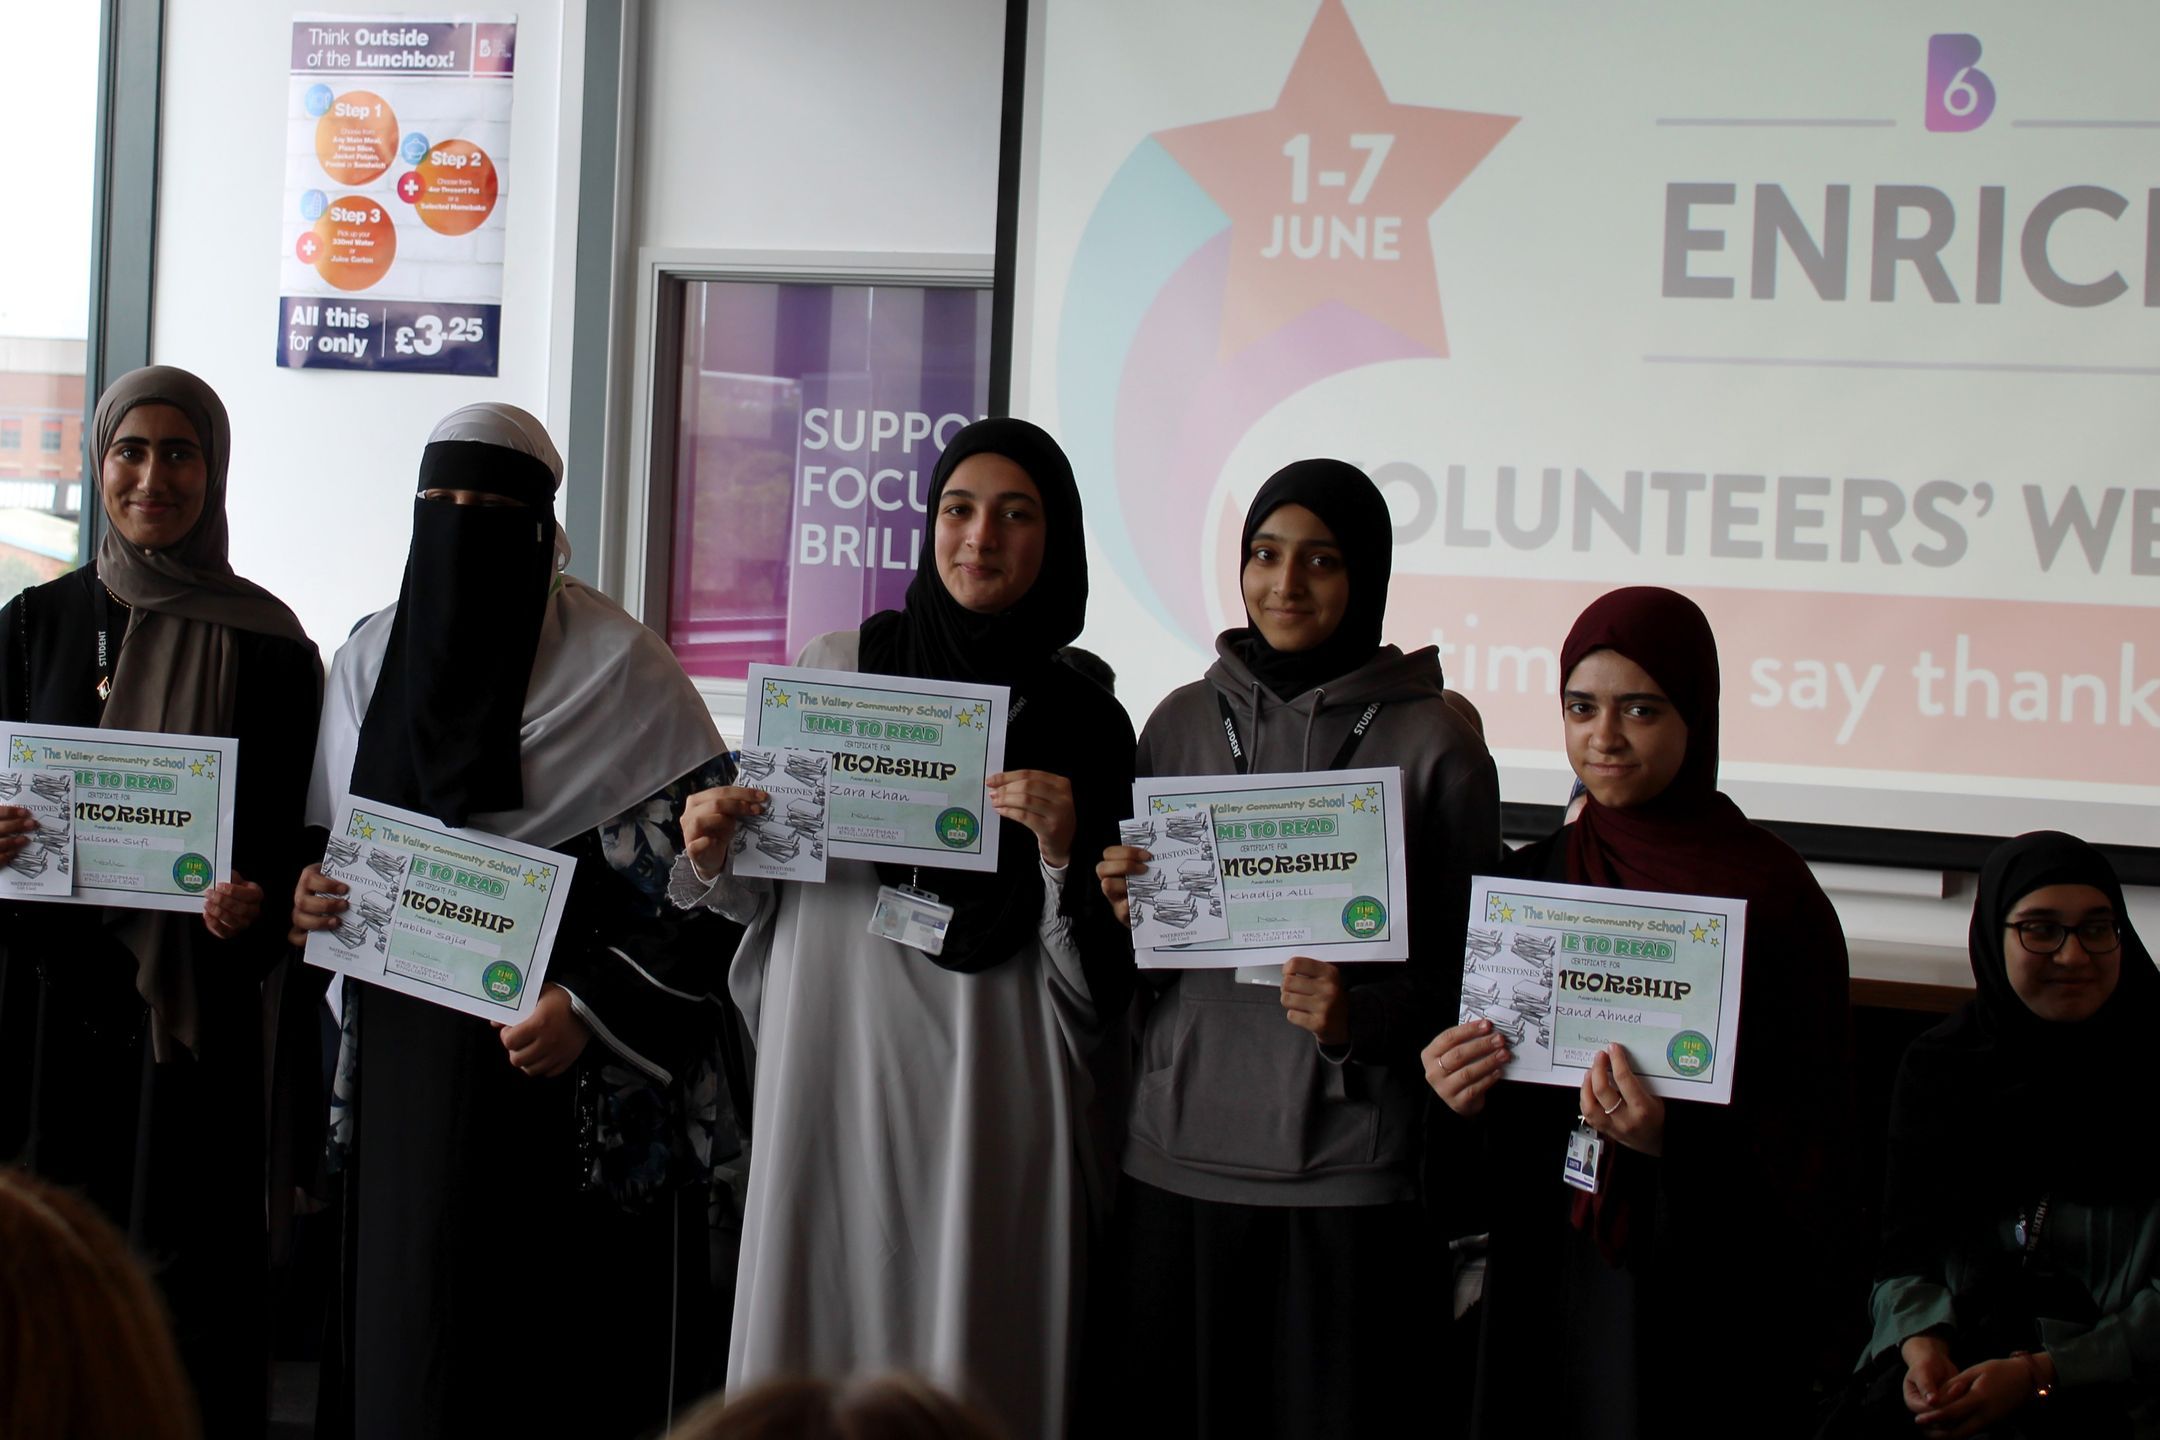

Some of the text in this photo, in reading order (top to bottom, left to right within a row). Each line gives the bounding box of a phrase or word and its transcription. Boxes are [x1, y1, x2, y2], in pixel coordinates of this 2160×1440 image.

[309, 28, 429, 47] Think Outside
[307, 49, 455, 68] of the Lunchbox!
[335, 103, 381, 120] Step 1
[431, 152, 482, 170] Step 2
[331, 207, 380, 225] Step 3
[354, 239, 375, 247] Water
[1261, 215, 1403, 260] JUNE
[1662, 182, 2160, 308] ENRIC
[291, 306, 370, 328] All this
[290, 332, 368, 358] for only
[395, 315, 484, 357] £3.25
[803, 408, 988, 454] SUPPO
[1352, 461, 1994, 567] OLUNTEERS’
[98, 630, 107, 667] STUDENT
[1750, 657, 1885, 745] say
[1912, 634, 2160, 729] thank
[798, 692, 952, 719] The Valley Community School
[804, 715, 939, 743] TIME TO READ
[1224, 717, 1242, 758] STUDENT
[844, 741, 891, 752] CERTIFICATE FOR
[43, 747, 186, 770] The Valley Community School
[98, 771, 123, 787] TO
[125, 774, 174, 791] READ
[88, 791, 120, 800] CERTIFICATE
[830, 784, 910, 802] Zara Khan
[1246, 801, 1305, 812] Community
[1308, 794, 1345, 808] School
[950, 816, 968, 825] TIME
[1249, 821, 1278, 838] TO
[1279, 817, 1336, 837] READ
[382, 827, 400, 842] The
[402, 834, 430, 852] Valley
[433, 845, 485, 867] Community
[487, 859, 521, 878] School
[1240, 842, 1288, 853] CERTIFICATE FOR
[186, 862, 202, 870] TIME
[1219, 851, 1357, 877] NTORSHIP
[333, 871, 388, 891] WATERSTONES
[416, 880, 448, 894] CERTIFICATE
[430, 864, 453, 882] TO
[455, 869, 506, 897] READ
[1230, 889, 1282, 901] Khadija
[1357, 906, 1375, 914] TIME
[1523, 905, 1686, 935] The Valley Community School
[1582, 934, 1612, 953] TO
[1614, 938, 1673, 960] READ
[1477, 963, 1541, 978] WATERSTONES
[1571, 957, 1621, 969] CERTIFICATE FOR
[497, 970, 514, 979] TIME
[1597, 1008, 1642, 1023] Ahmed
[1683, 1041, 1702, 1050] TIME
